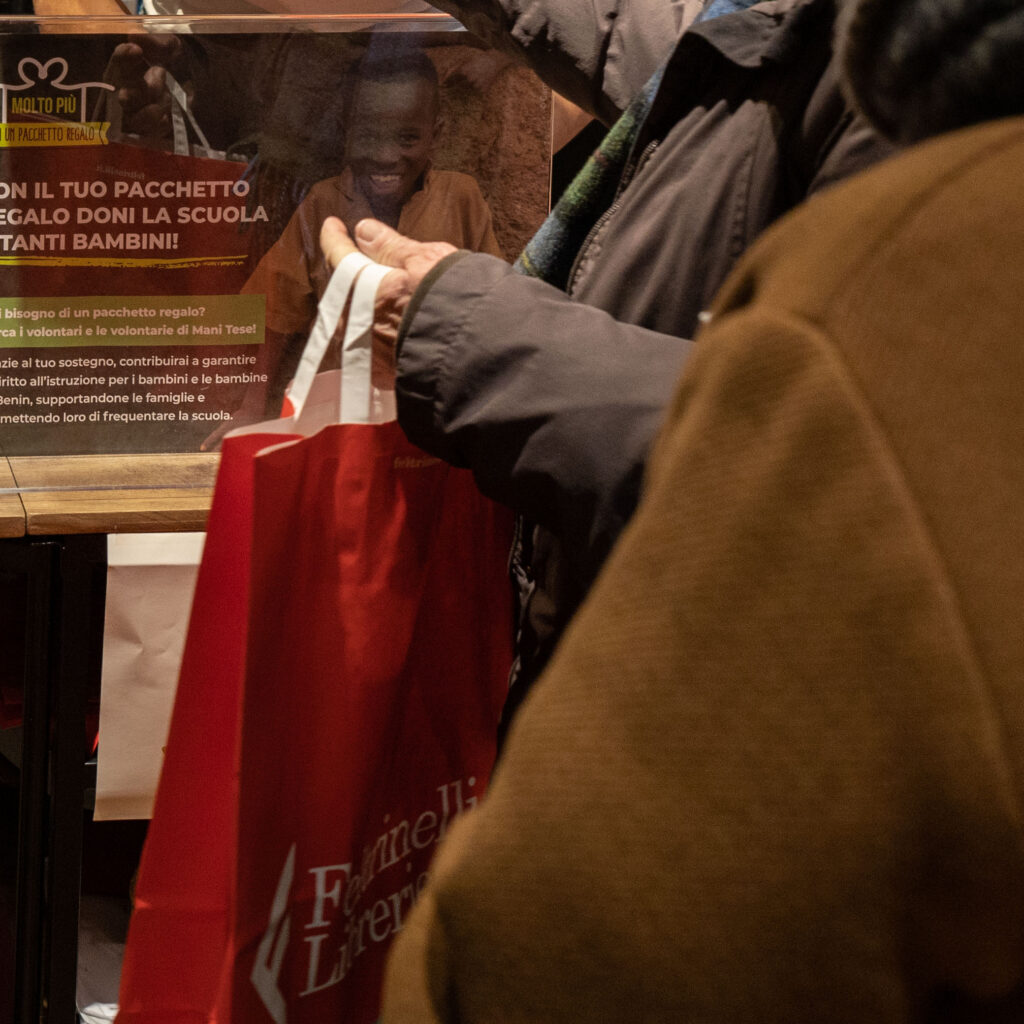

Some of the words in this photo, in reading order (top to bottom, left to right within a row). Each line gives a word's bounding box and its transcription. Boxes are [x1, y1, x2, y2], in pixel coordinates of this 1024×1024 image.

[12, 97, 53, 114] MOLTO
[56, 94, 76, 113] PIÙ
[5, 128, 14, 141] UN
[18, 127, 63, 141] PACCHETTO
[67, 127, 95, 141] REGALO
[35, 182, 54, 199] IL
[60, 181, 107, 198] TUO
[114, 180, 250, 198] PACCHETTO
[77, 206, 135, 224] DONI
[142, 207, 172, 224] LA
[177, 205, 269, 224] SCUOLA
[0, 233, 66, 251] TANTI
[73, 233, 179, 250] BAMBINI!
[5, 308, 56, 322] bisogno
[58, 307, 71, 319] di
[74, 309, 90, 318] un
[93, 306, 156, 320] pacchetto
[159, 307, 206, 320] regalo?
[19, 326, 23, 337] i
[26, 325, 82, 337] volontari
[85, 328, 93, 337] e
[96, 325, 107, 336] le
[111, 325, 174, 336] volontarie
[177, 324, 189, 335] di
[192, 324, 222, 335] Mani
[225, 324, 256, 335] Tese!
[22, 357, 32, 368] al
[35, 359, 56, 368] tuo
[59, 357, 116, 370] sostegno,
[119, 355, 189, 367] contribuirai
[192, 358, 199, 366] a
[202, 355, 256, 368] garantire
[29, 375, 105, 386] all'istruzione
[108, 376, 129, 388] per
[132, 374, 135, 385] i
[139, 373, 188, 385] bambini
[191, 375, 198, 384] e
[201, 373, 212, 384] le
[215, 372, 268, 384] bambine
[36, 393, 129, 406] supportandone
[132, 392, 143, 403] le
[146, 391, 194, 405] famiglie
[197, 394, 205, 403] e
[63, 412, 86, 423] loro
[89, 411, 100, 422] di
[103, 410, 175, 424] frequentare
[178, 410, 189, 421] la
[192, 409, 233, 421] scuola.
